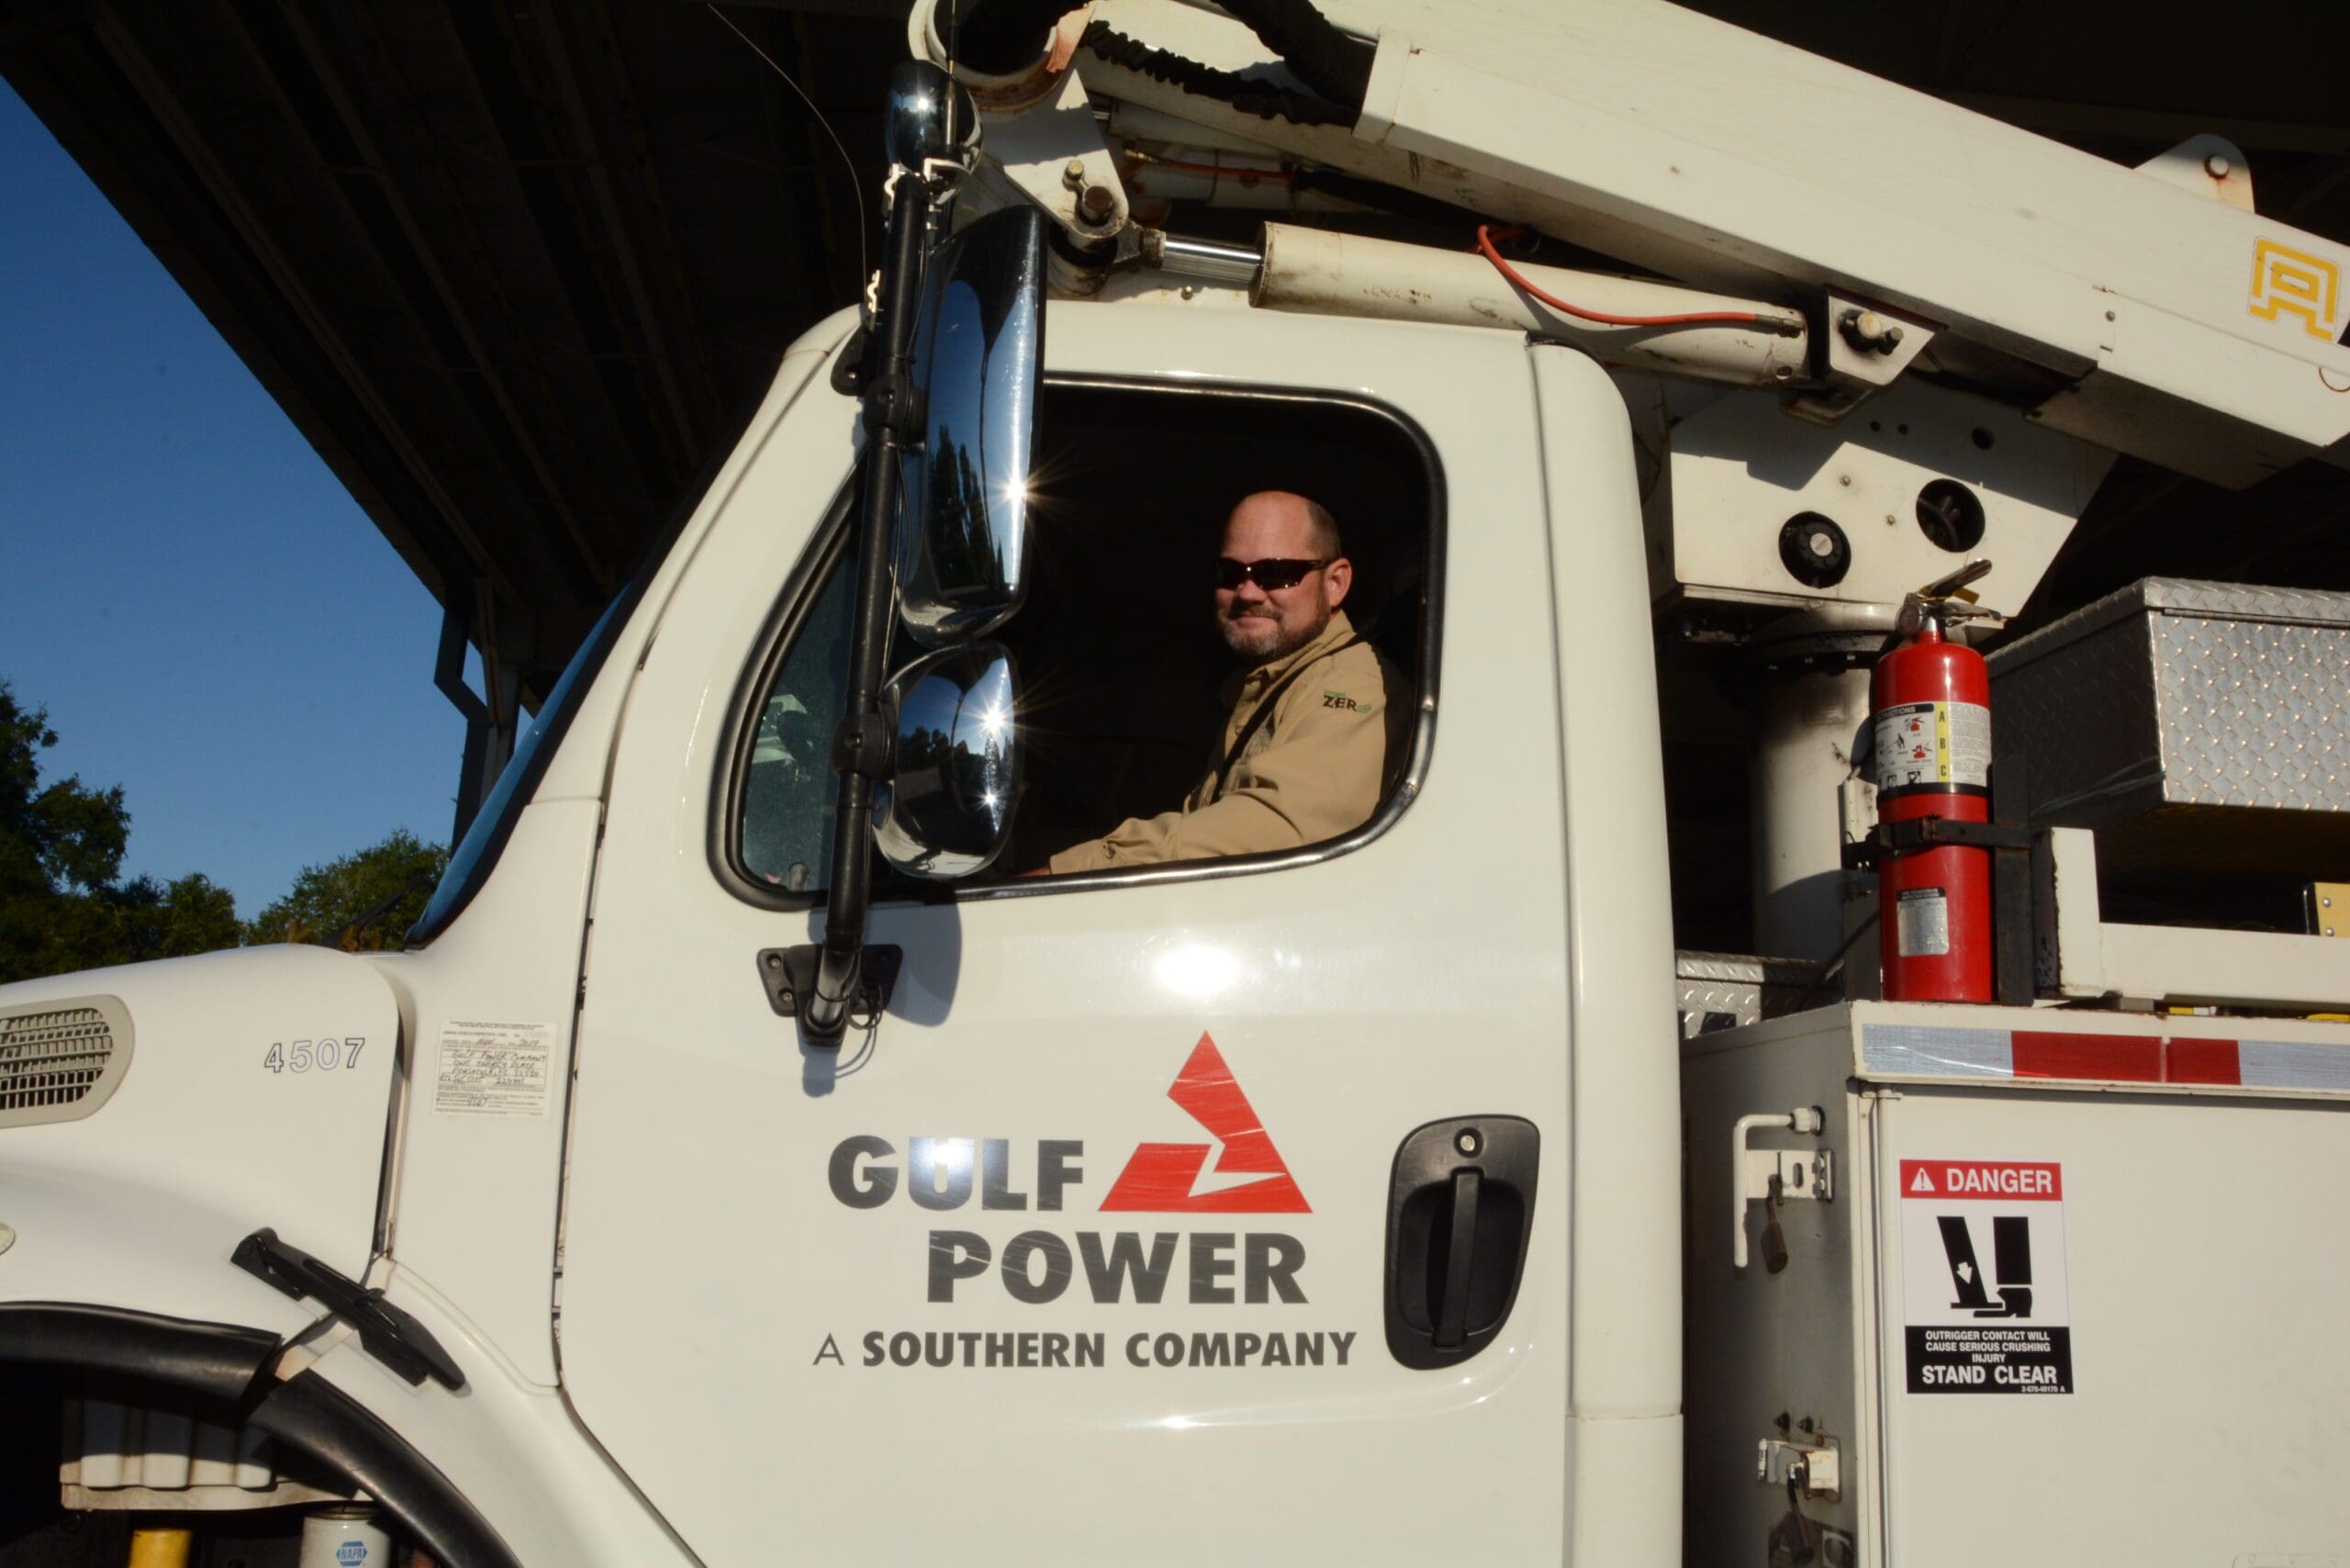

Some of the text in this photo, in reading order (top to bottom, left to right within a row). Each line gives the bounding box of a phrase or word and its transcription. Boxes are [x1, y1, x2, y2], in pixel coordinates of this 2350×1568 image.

[1939, 711, 1947, 778] A B C
[263, 1037, 365, 1073] 4507
[828, 1135, 1084, 1211] GULF
[1946, 1168, 2053, 1193] DANGER
[927, 1230, 1309, 1304] POWER
[1925, 1330, 2050, 1341] OUTRIGGER CONTACT WILL
[1926, 1342, 2051, 1352] CAUSE SERIOUS CRUSHING
[812, 1330, 1357, 1368] A SOUTHERN COMPANY
[1972, 1353, 2006, 1363] INJURY
[1922, 1365, 2057, 1384] STAND CLEAR
[340, 1547, 364, 1560] NAPA
